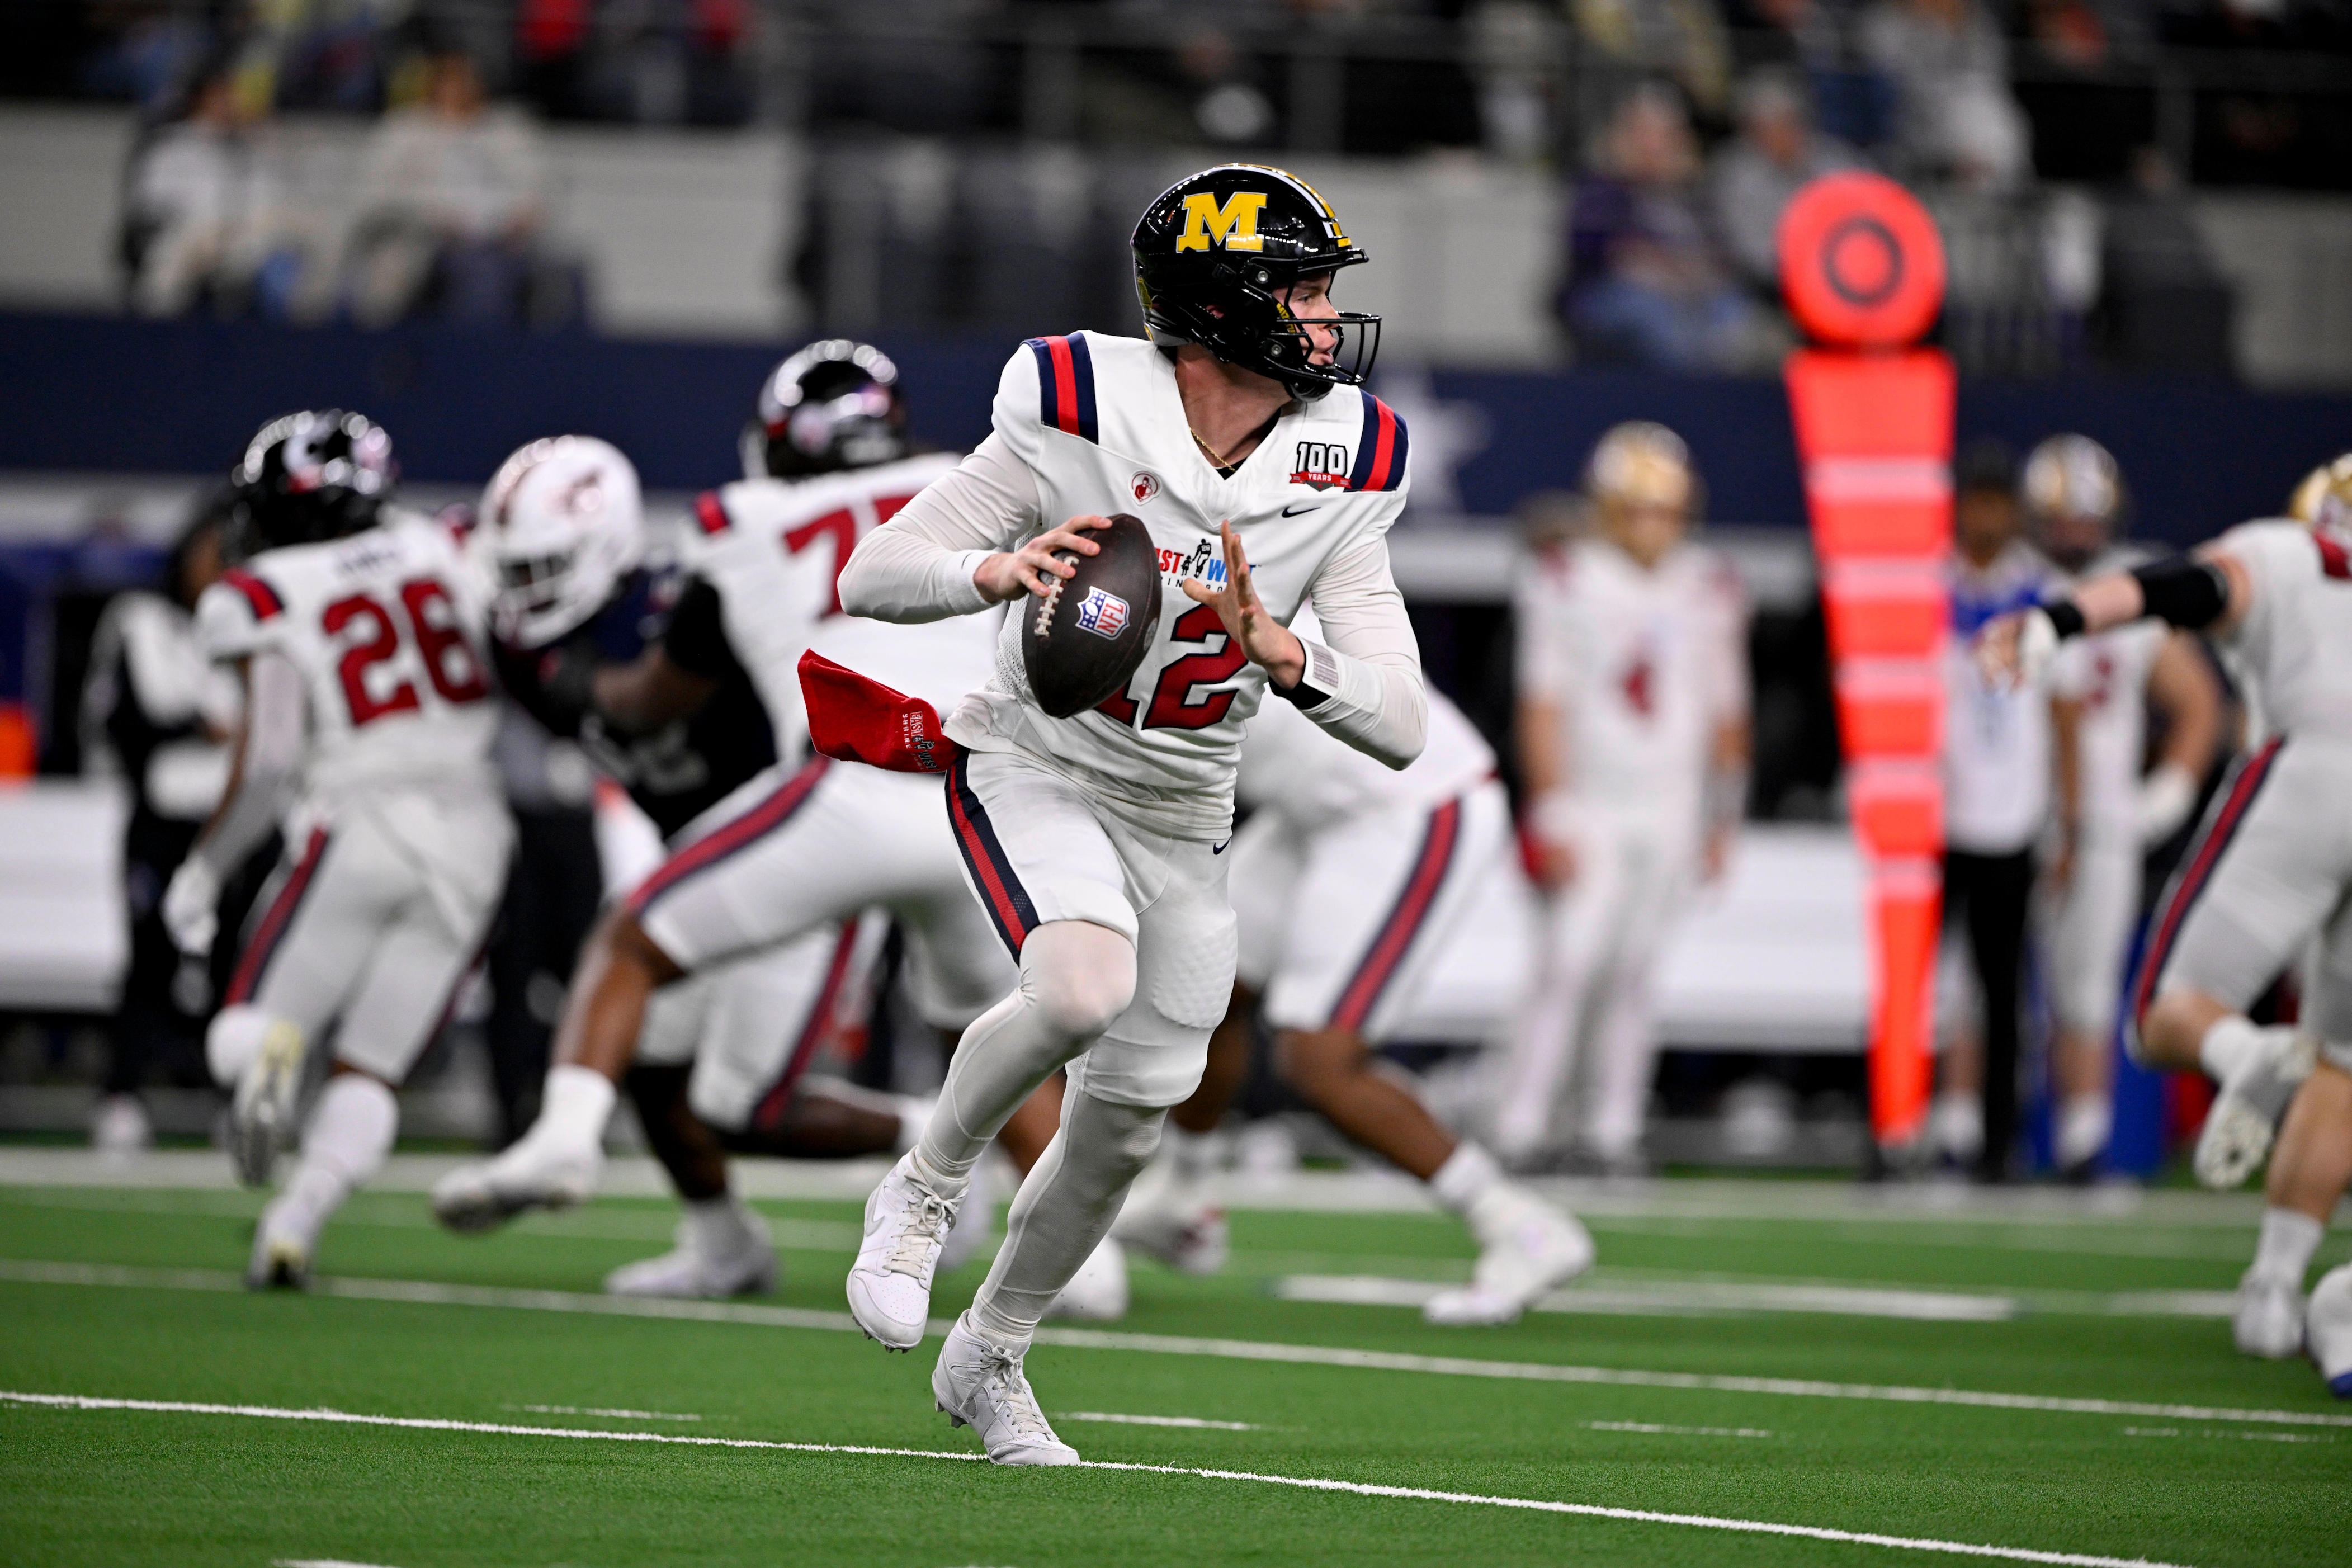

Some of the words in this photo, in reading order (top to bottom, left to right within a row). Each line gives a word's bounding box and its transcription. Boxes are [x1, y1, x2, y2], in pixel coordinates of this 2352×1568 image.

[1176, 191, 1268, 253] M
[1296, 441, 1347, 478] 100
[1097, 603, 1123, 635] NFL
[322, 576, 488, 728] 26
[902, 713, 912, 749] SHRINE
[910, 711, 923, 736] EAST
